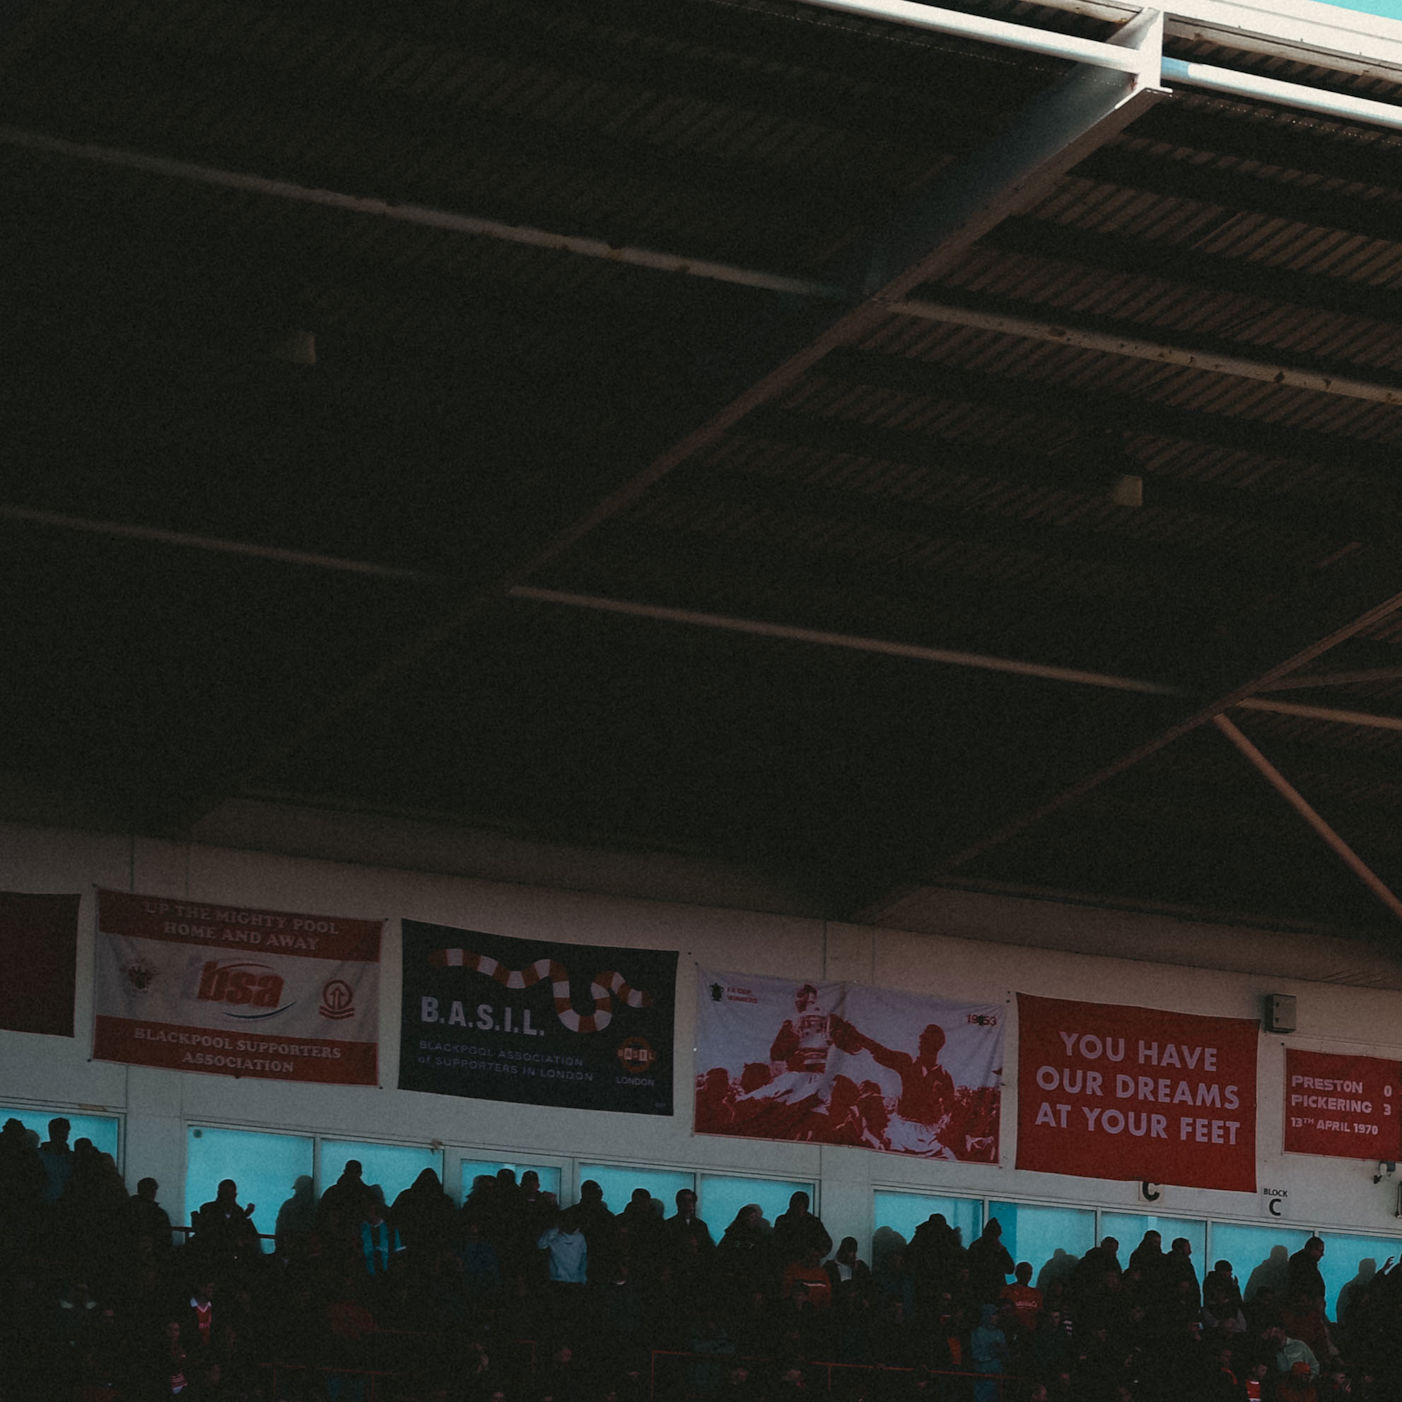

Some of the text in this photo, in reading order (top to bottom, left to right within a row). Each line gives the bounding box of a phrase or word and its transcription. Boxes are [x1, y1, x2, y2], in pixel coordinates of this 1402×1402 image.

[175, 905, 211, 920] THE
[215, 909, 288, 929] MIGHTY
[292, 919, 339, 935] POOL
[164, 921, 321, 951] HOME AND AWAY
[420, 995, 545, 1037] B.A.S.I.L.
[133, 1027, 342, 1060] BLACKPOOL SUPPORTERS
[419, 1040, 585, 1067] BLACKPOOL ASSOCIATION
[1058, 1031, 1217, 1072] YOU HAVE
[182, 1052, 294, 1073] ASSOCIATION
[417, 1055, 594, 1082] of SUPPORTERS IN LONDON
[615, 1076, 655, 1088] LONDON
[1035, 1065, 1240, 1110] OUR DREAMS
[1291, 1075, 1393, 1098] PRESTON 0
[1291, 1094, 1392, 1116] PICKERING 3
[1034, 1102, 1241, 1145] AT YOUR FEET
[1316, 1119, 1351, 1133] APRIL
[1353, 1122, 1379, 1136] 1970
[1263, 1188, 1288, 1197] BLOCK
[1269, 1199, 1282, 1216] C
